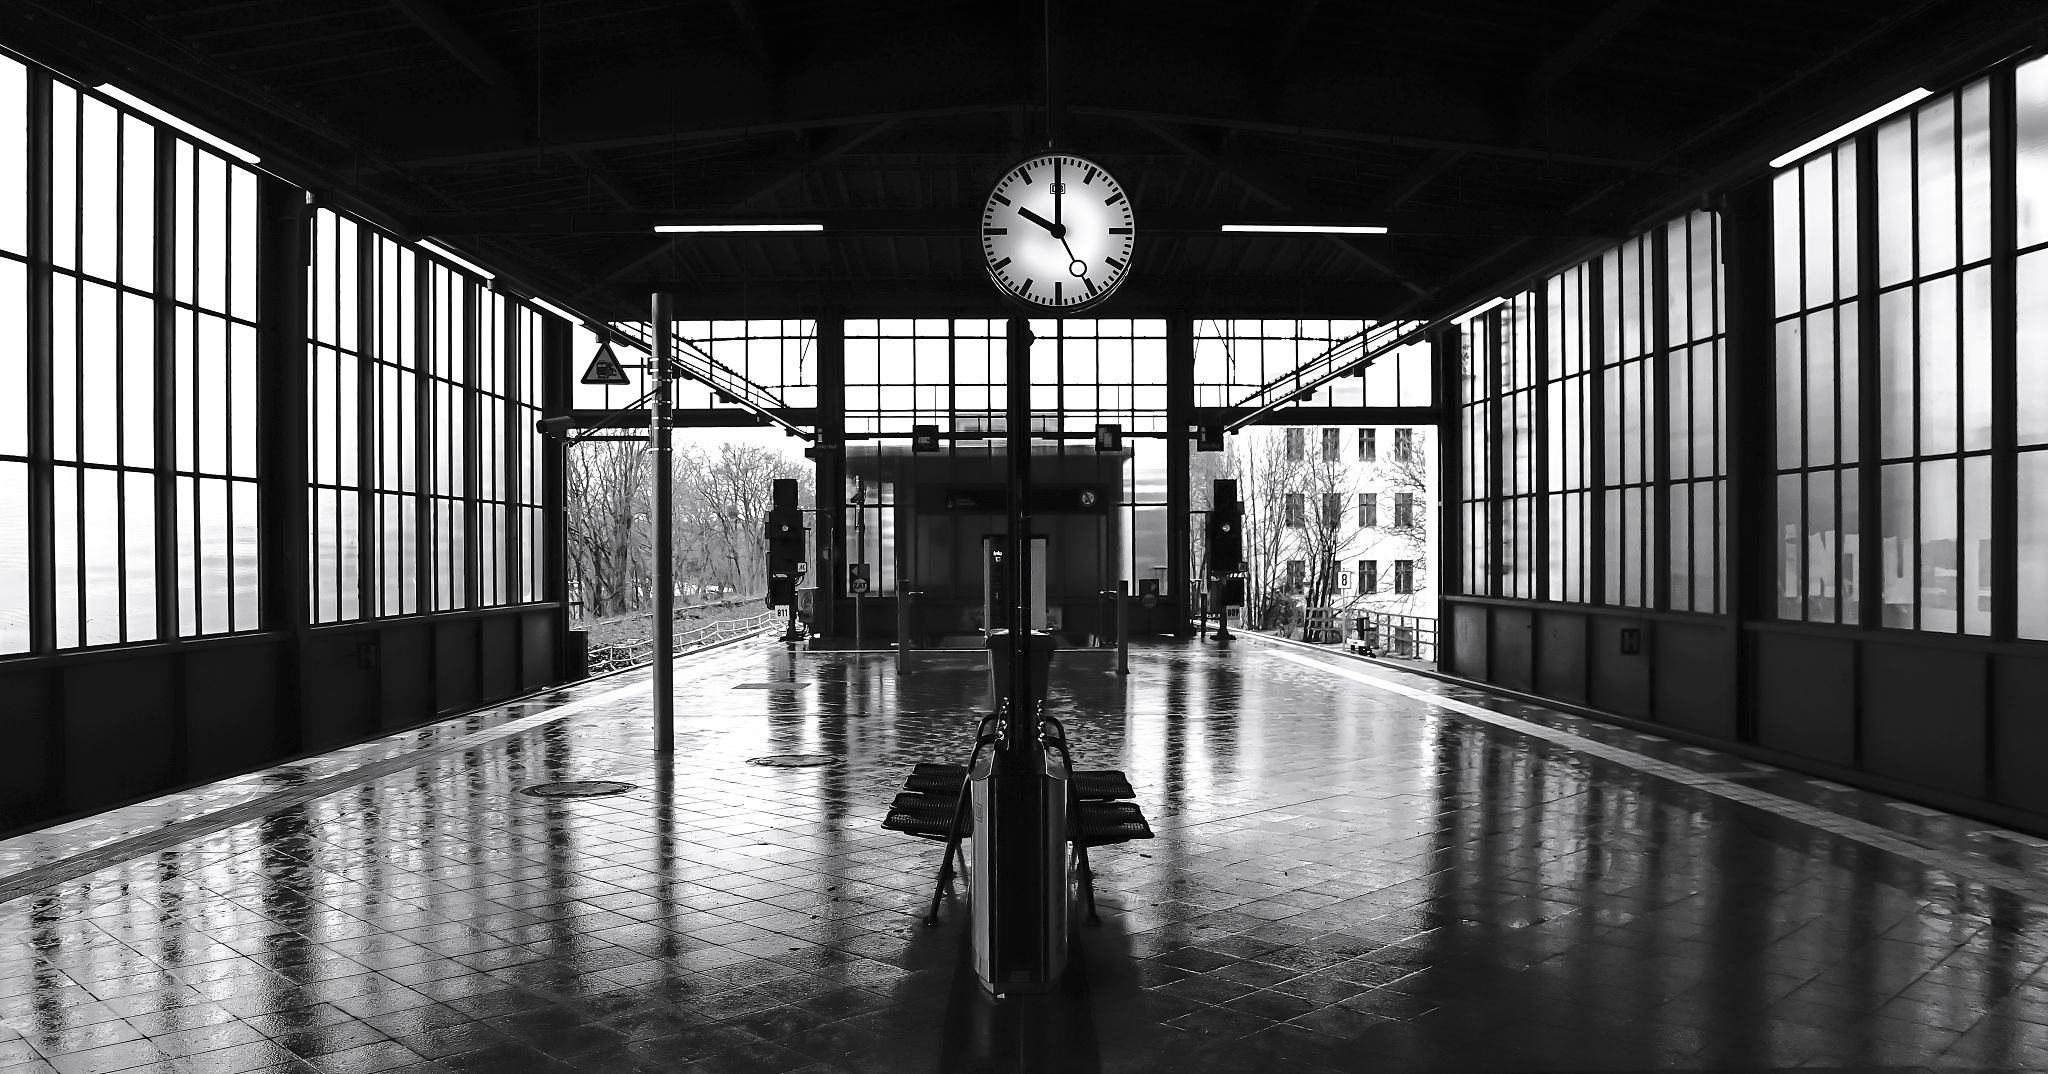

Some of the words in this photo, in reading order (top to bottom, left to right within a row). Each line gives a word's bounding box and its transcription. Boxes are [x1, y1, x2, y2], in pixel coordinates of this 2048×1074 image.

[1341, 574, 1347, 586] 8
[777, 609, 788, 617] B11
[360, 646, 376, 666] H
